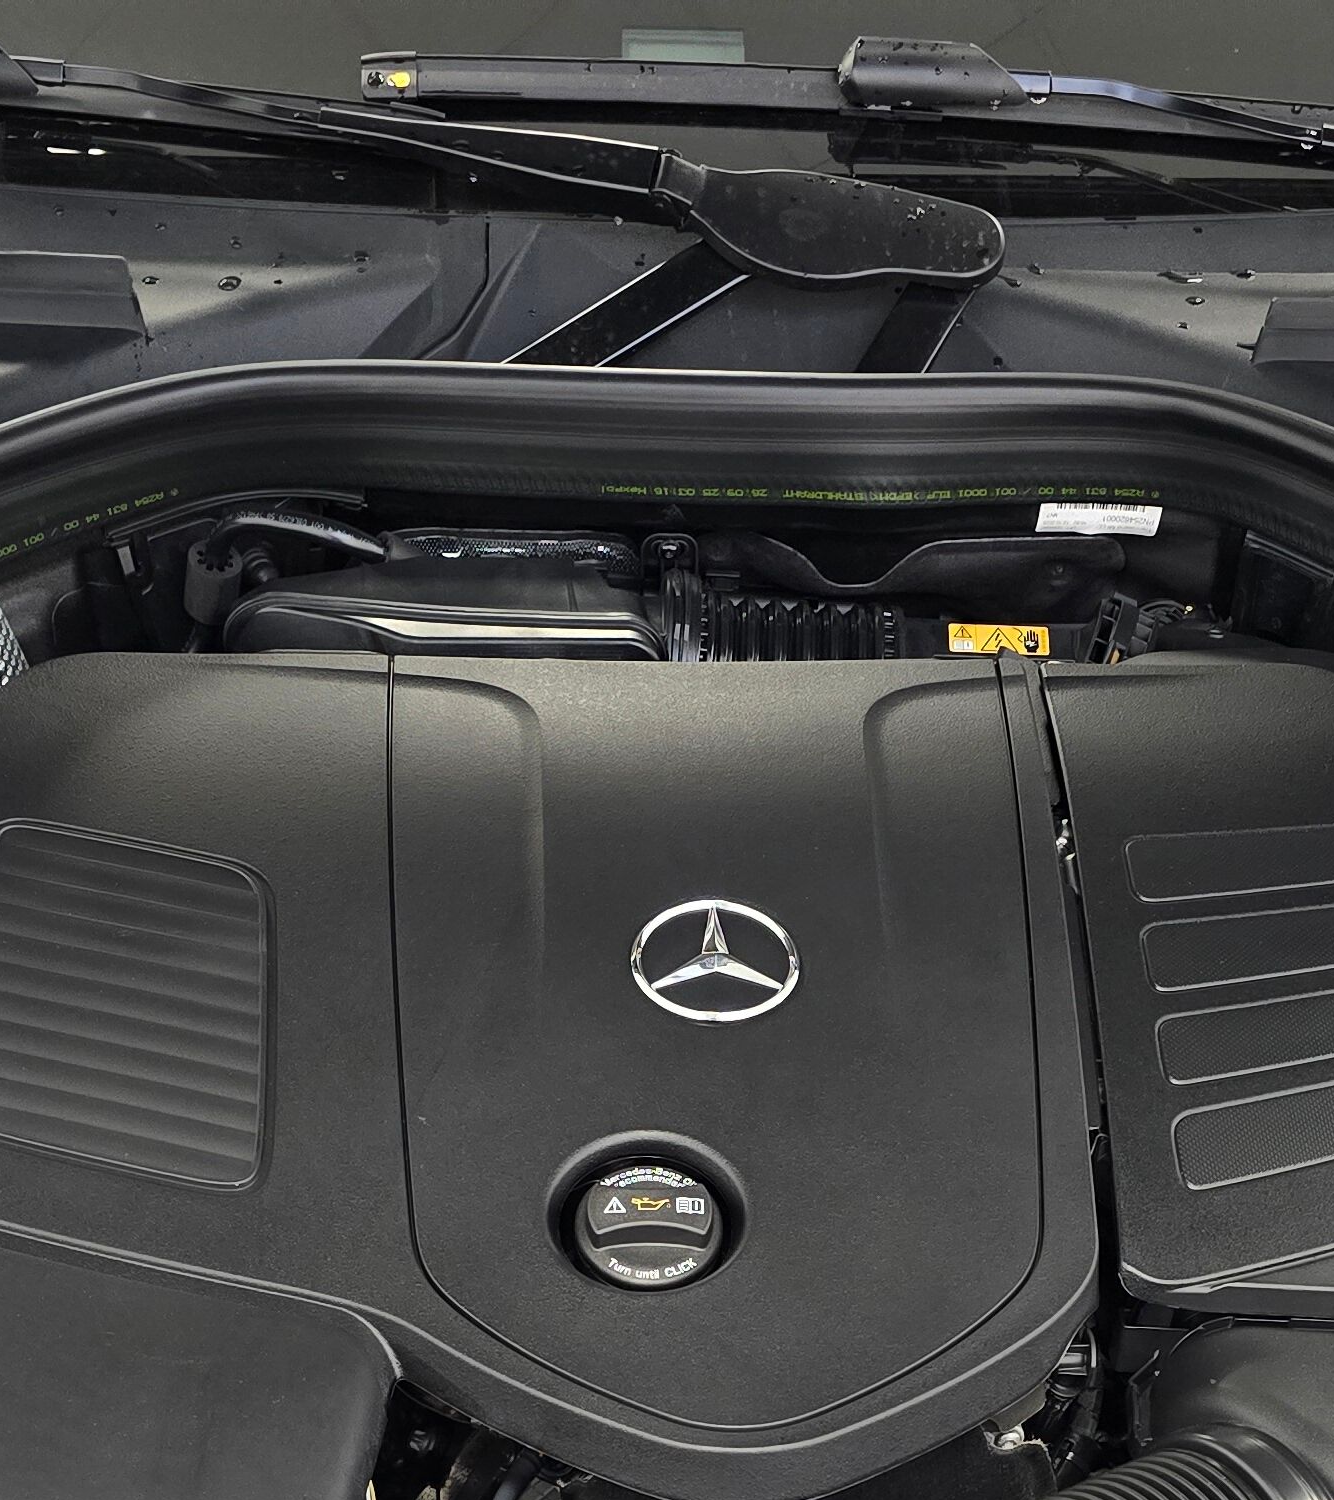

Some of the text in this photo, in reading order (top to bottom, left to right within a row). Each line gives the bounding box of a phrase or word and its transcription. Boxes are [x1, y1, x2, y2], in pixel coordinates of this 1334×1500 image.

[994, 486, 1016, 497] 001
[1037, 486, 1054, 496] 00
[1060, 487, 1076, 496] 44
[1085, 486, 1107, 497] 831
[1114, 486, 1144, 498] A254
[134, 491, 165, 508] A254
[107, 502, 128, 516] 831
[84, 512, 100, 524] 44
[64, 520, 79, 533] 00
[23, 532, 44, 546] 001
[608, 1257, 698, 1280] Turn until CLICK
